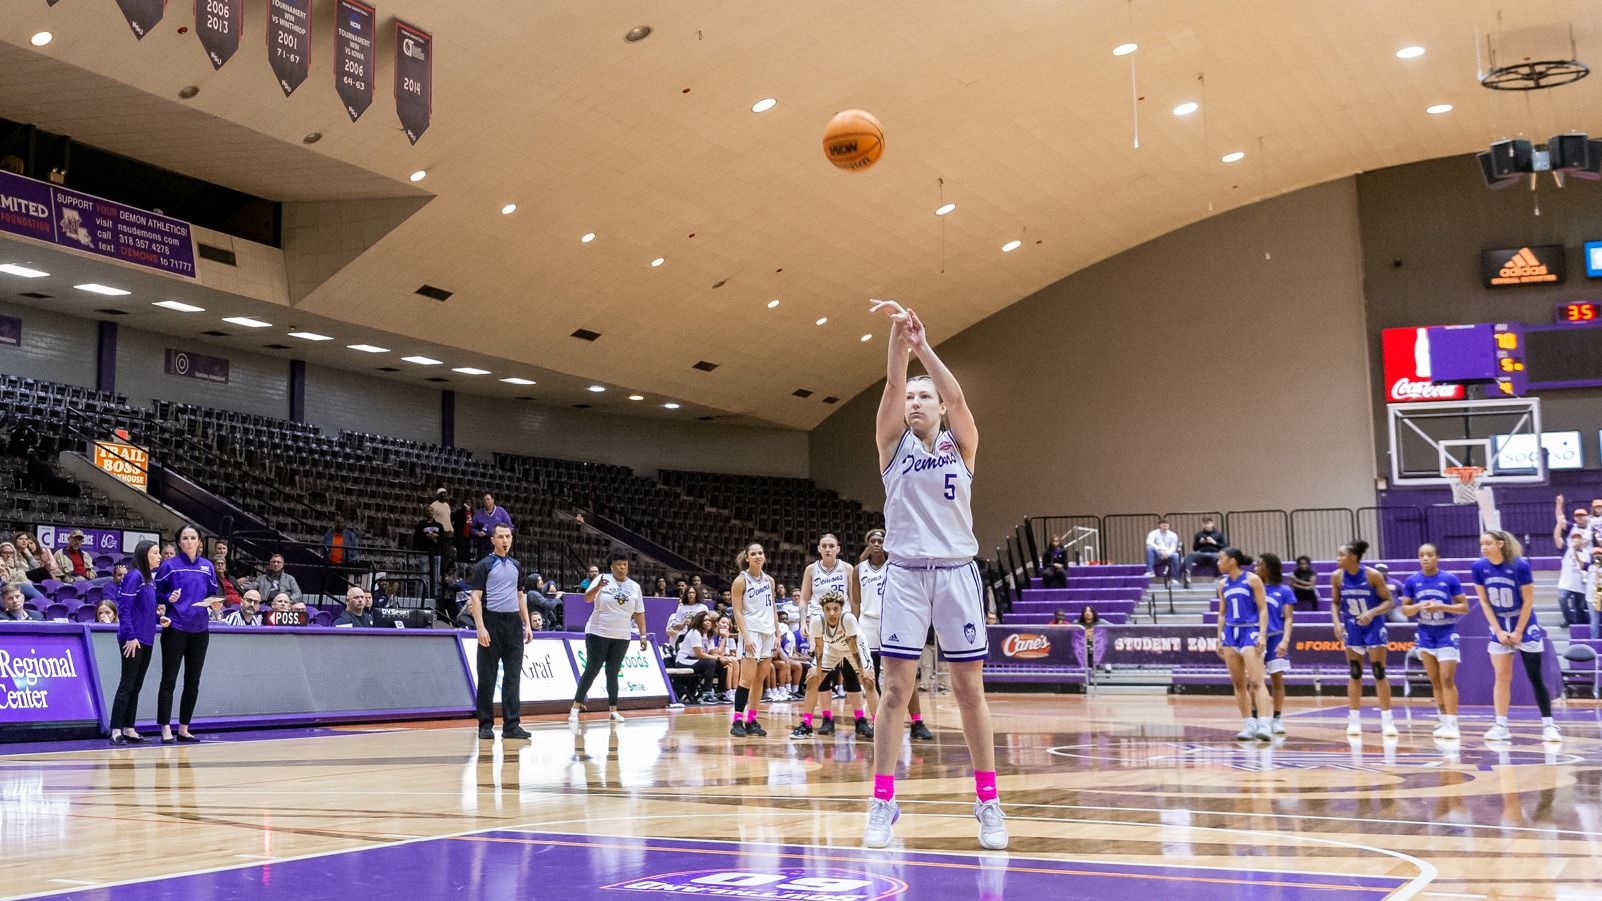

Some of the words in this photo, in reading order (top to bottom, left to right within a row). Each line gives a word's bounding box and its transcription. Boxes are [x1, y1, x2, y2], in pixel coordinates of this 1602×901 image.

[207, 0, 229, 18] 2006
[272, 0, 306, 19] TOURNAMENT
[284, 12, 294, 22] WIN
[207, 15, 228, 33] 2013
[272, 15, 278, 24] VS
[280, 18, 306, 35] WINTHROP
[278, 30, 298, 50] 2001
[338, 28, 370, 47] TOURNAMENT
[350, 41, 360, 50] WIN
[277, 48, 300, 63] 71-67
[344, 46, 351, 55] VS
[352, 50, 364, 60] IOWA
[344, 59, 364, 76] 2006
[344, 76, 365, 90] 64-63
[404, 77, 420, 96] 2014
[1, 211, 49, 232] FOUNDATION
[57, 193, 94, 210] SUPPORT
[96, 204, 117, 217] YOUR
[120, 210, 146, 226] DEMON
[148, 218, 188, 236] ATHLETICS!
[96, 217, 112, 228] visit
[97, 230, 112, 240] call
[98, 240, 114, 252] text
[120, 246, 158, 263] DEMONS
[160, 256, 168, 266] to
[170, 258, 192, 272] 71777
[1500, 264, 1548, 278] adidas
[98, 445, 145, 462] TRAIL
[103, 459, 141, 474] BOSS
[902, 452, 957, 475] Demons
[944, 474, 958, 500] 5
[814, 575, 844, 587] Demons
[748, 584, 770, 598] Demons
[766, 594, 772, 606] 15
[1230, 598, 1240, 618] 1
[1004, 634, 1050, 656] Cane's
[1114, 636, 1181, 652] STUDENT
[1187, 636, 1220, 652] ZON
[0, 648, 78, 686] Regional
[520, 654, 554, 680] Graf
[620, 651, 649, 668] oods
